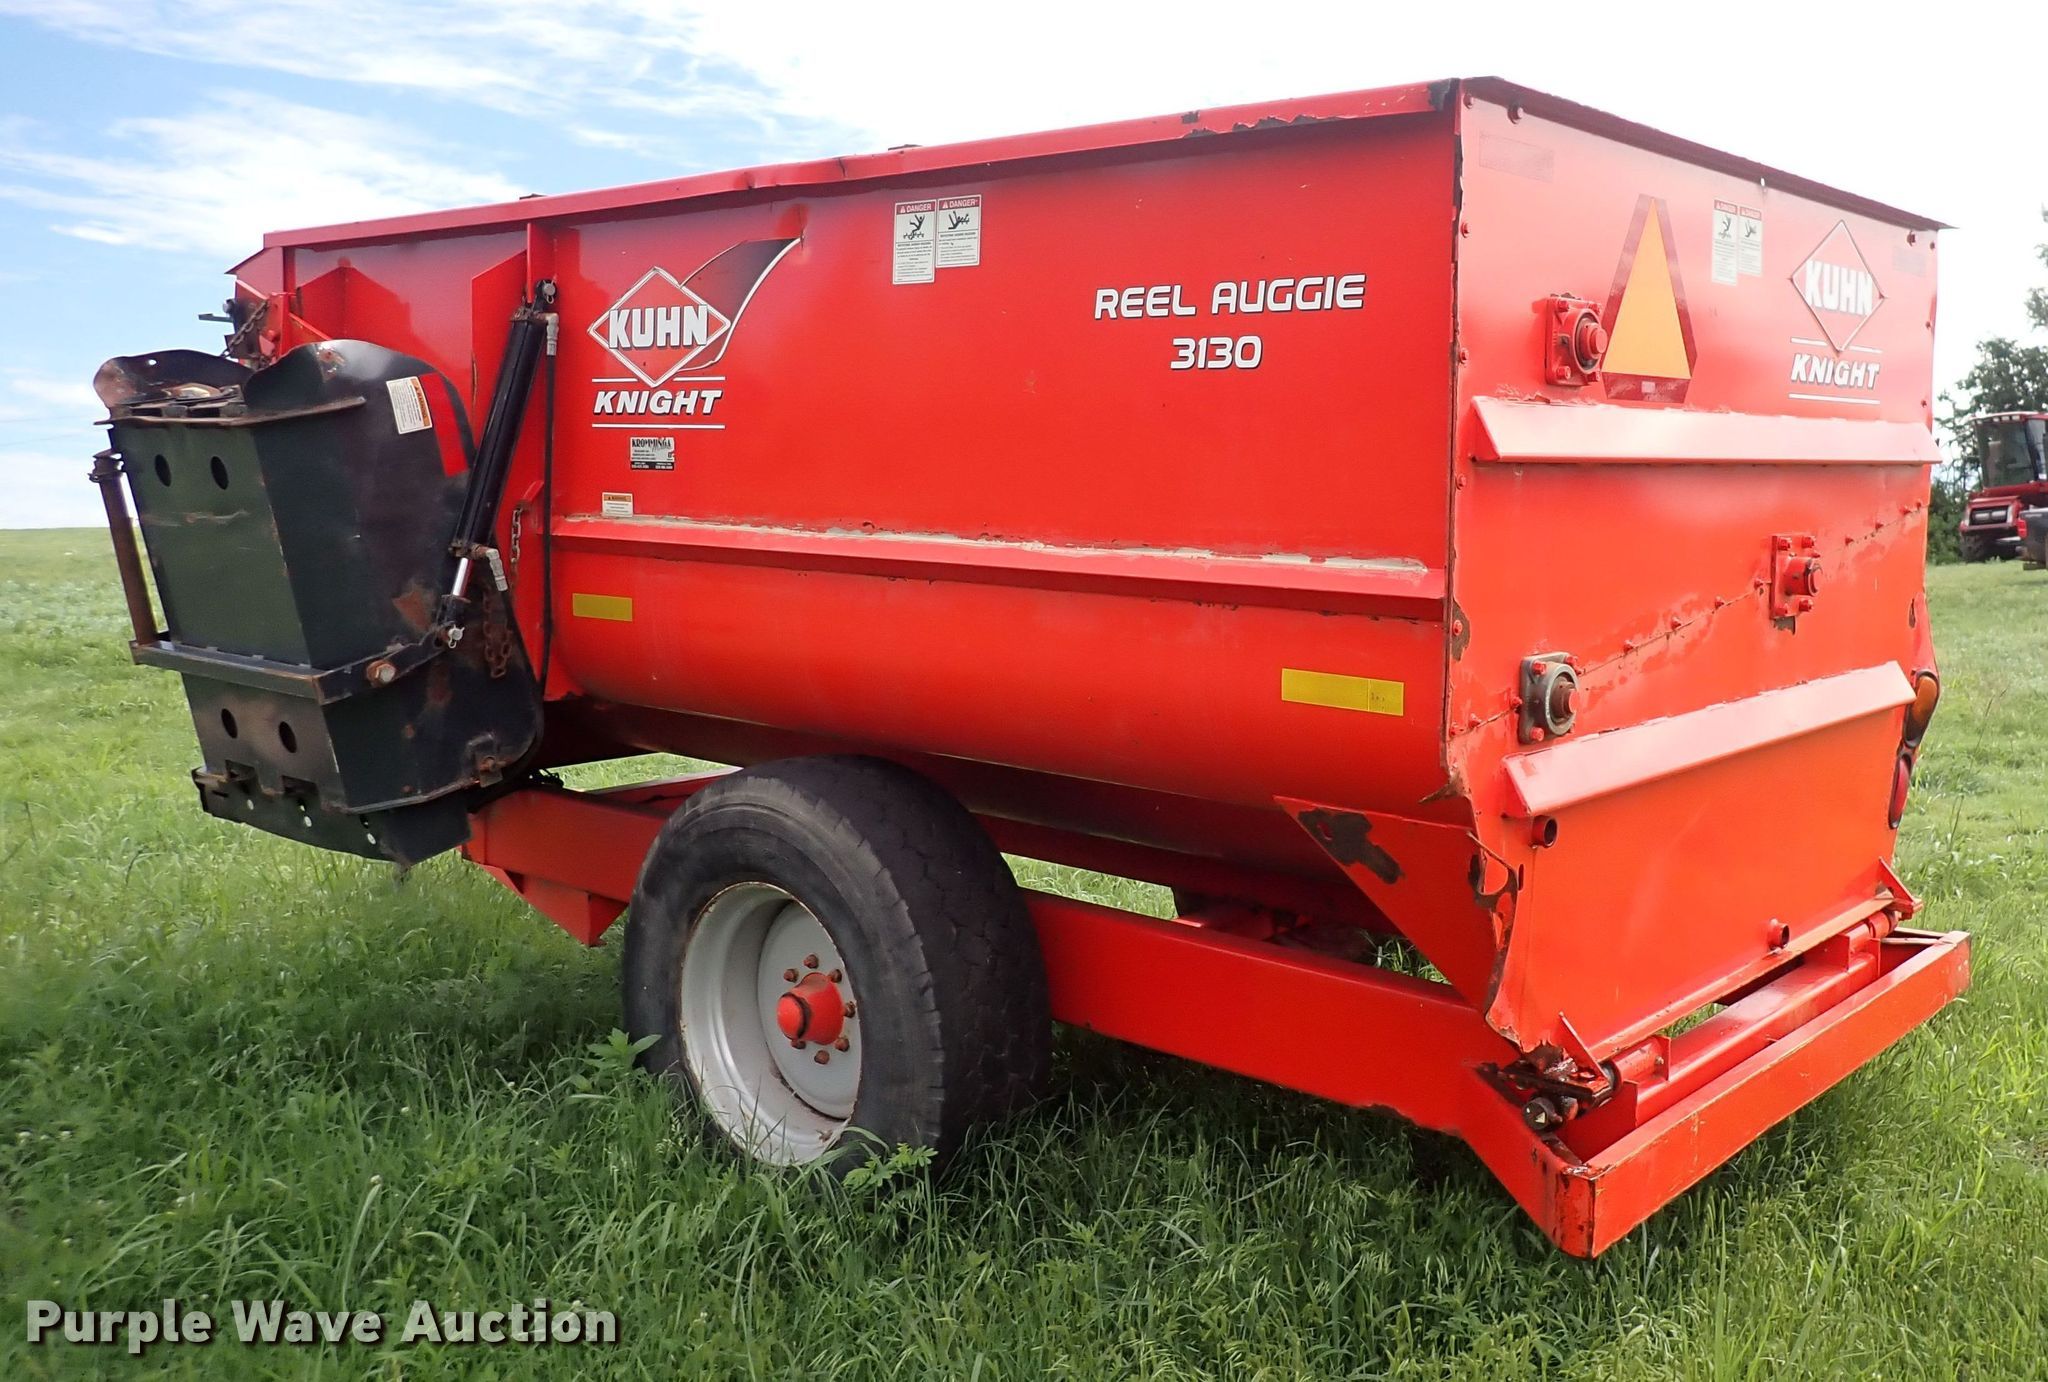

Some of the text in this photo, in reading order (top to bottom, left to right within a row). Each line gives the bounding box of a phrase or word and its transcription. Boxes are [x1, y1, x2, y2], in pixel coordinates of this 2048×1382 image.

[906, 203, 932, 213] DANGER
[949, 199, 976, 208] DANGER
[1095, 274, 1366, 319] REEL AUGGIE
[1805, 260, 1873, 316] KUHN
[608, 304, 708, 348] KUHN
[1170, 336, 1262, 369] 3130
[1790, 353, 1880, 389] KNIGHT
[593, 390, 723, 415] KNIGHT
